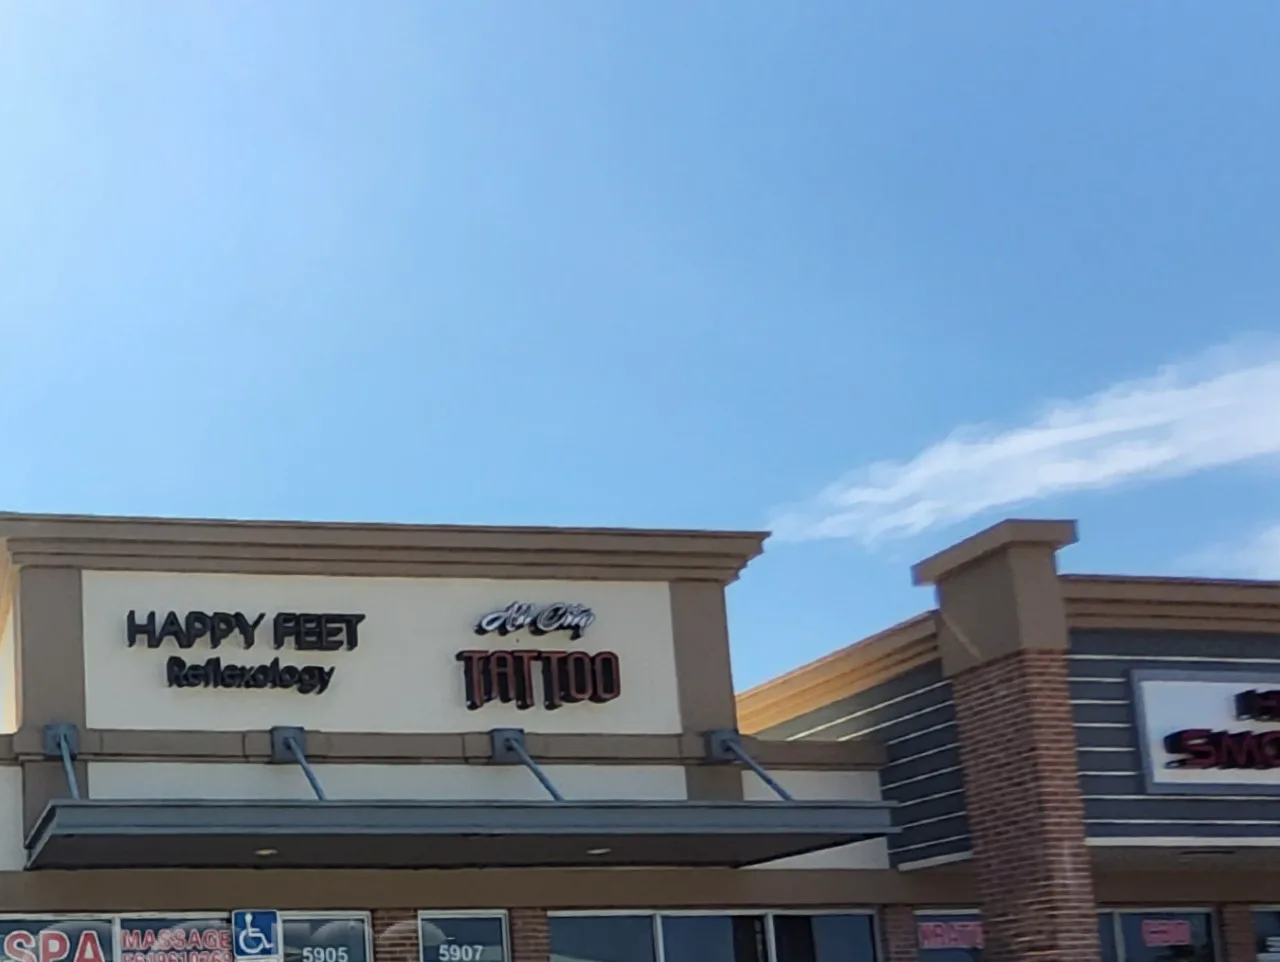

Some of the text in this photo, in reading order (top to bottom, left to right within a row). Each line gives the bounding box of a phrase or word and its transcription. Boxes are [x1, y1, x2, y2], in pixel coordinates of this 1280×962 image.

[125, 609, 367, 651] HAPPY FEET
[166, 655, 336, 695] Reflexology
[455, 649, 622, 711] TATTOO
[120, 927, 231, 951] MASSAGE
[438, 943, 483, 962] 5907
